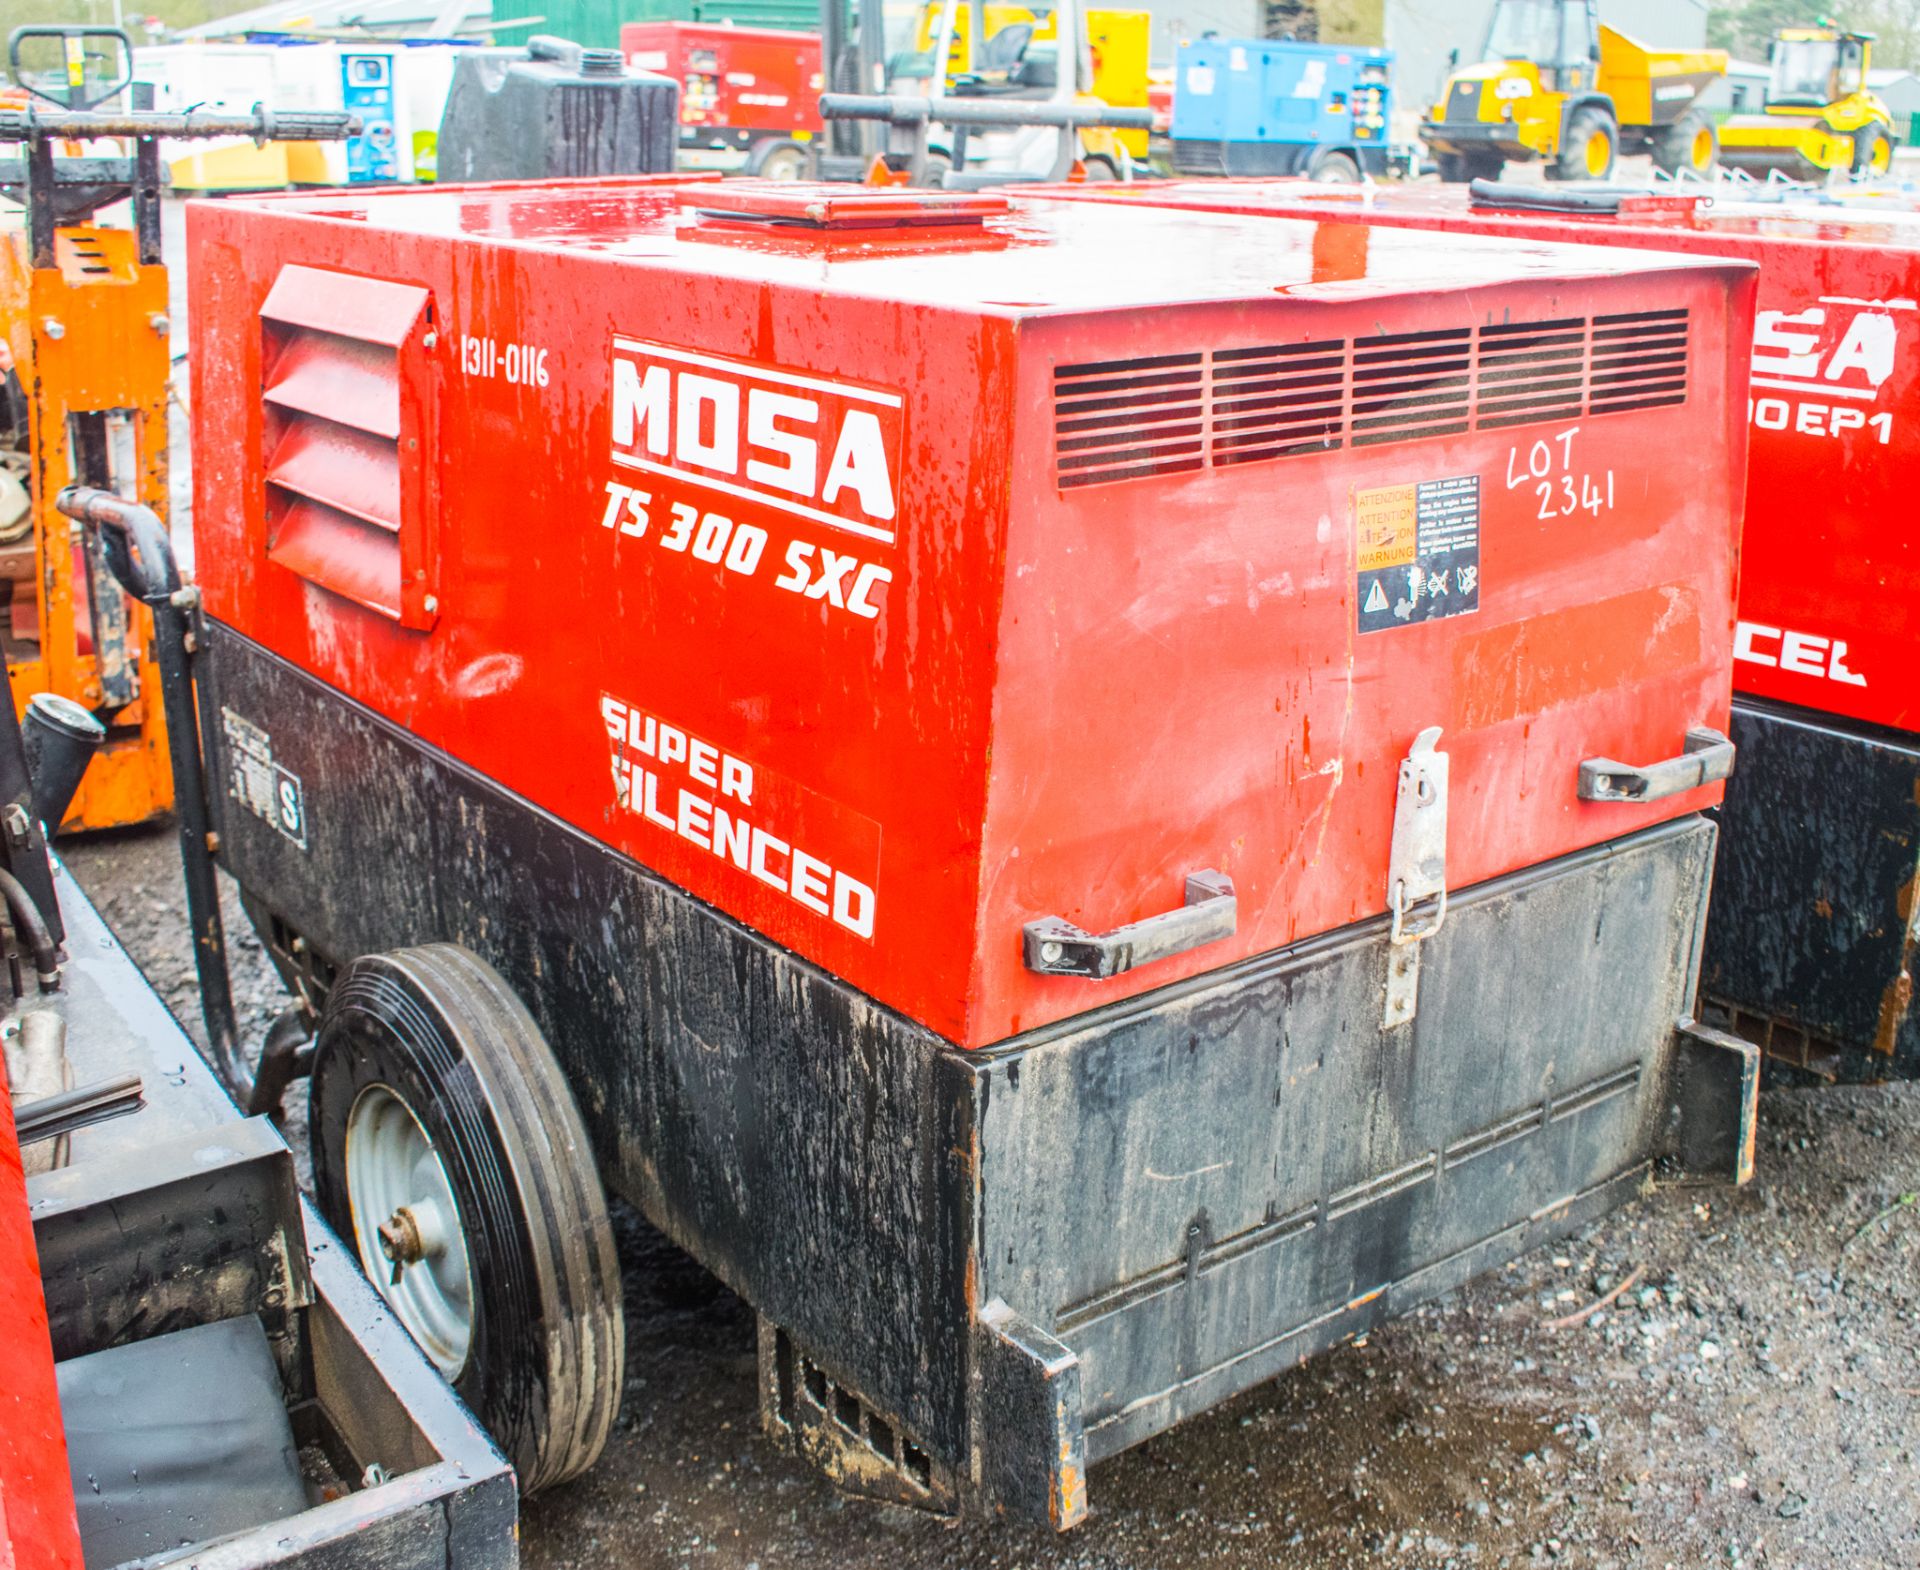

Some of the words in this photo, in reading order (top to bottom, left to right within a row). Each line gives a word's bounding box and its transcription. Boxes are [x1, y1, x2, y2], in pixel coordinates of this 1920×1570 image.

[461, 334, 549, 387] 1311-0116
[612, 358, 895, 520] MOSA
[1507, 427, 1580, 489] LOT
[1359, 489, 1413, 508] ATTENZIONE
[1359, 508, 1413, 526] ATTENTION
[1536, 470, 1613, 519] 2341
[602, 481, 652, 537] TS
[660, 501, 768, 576] 300
[775, 540, 893, 619] SXC
[1359, 546, 1413, 565] WARNUNG
[602, 696, 753, 806] SUPER
[280, 781, 299, 831] S
